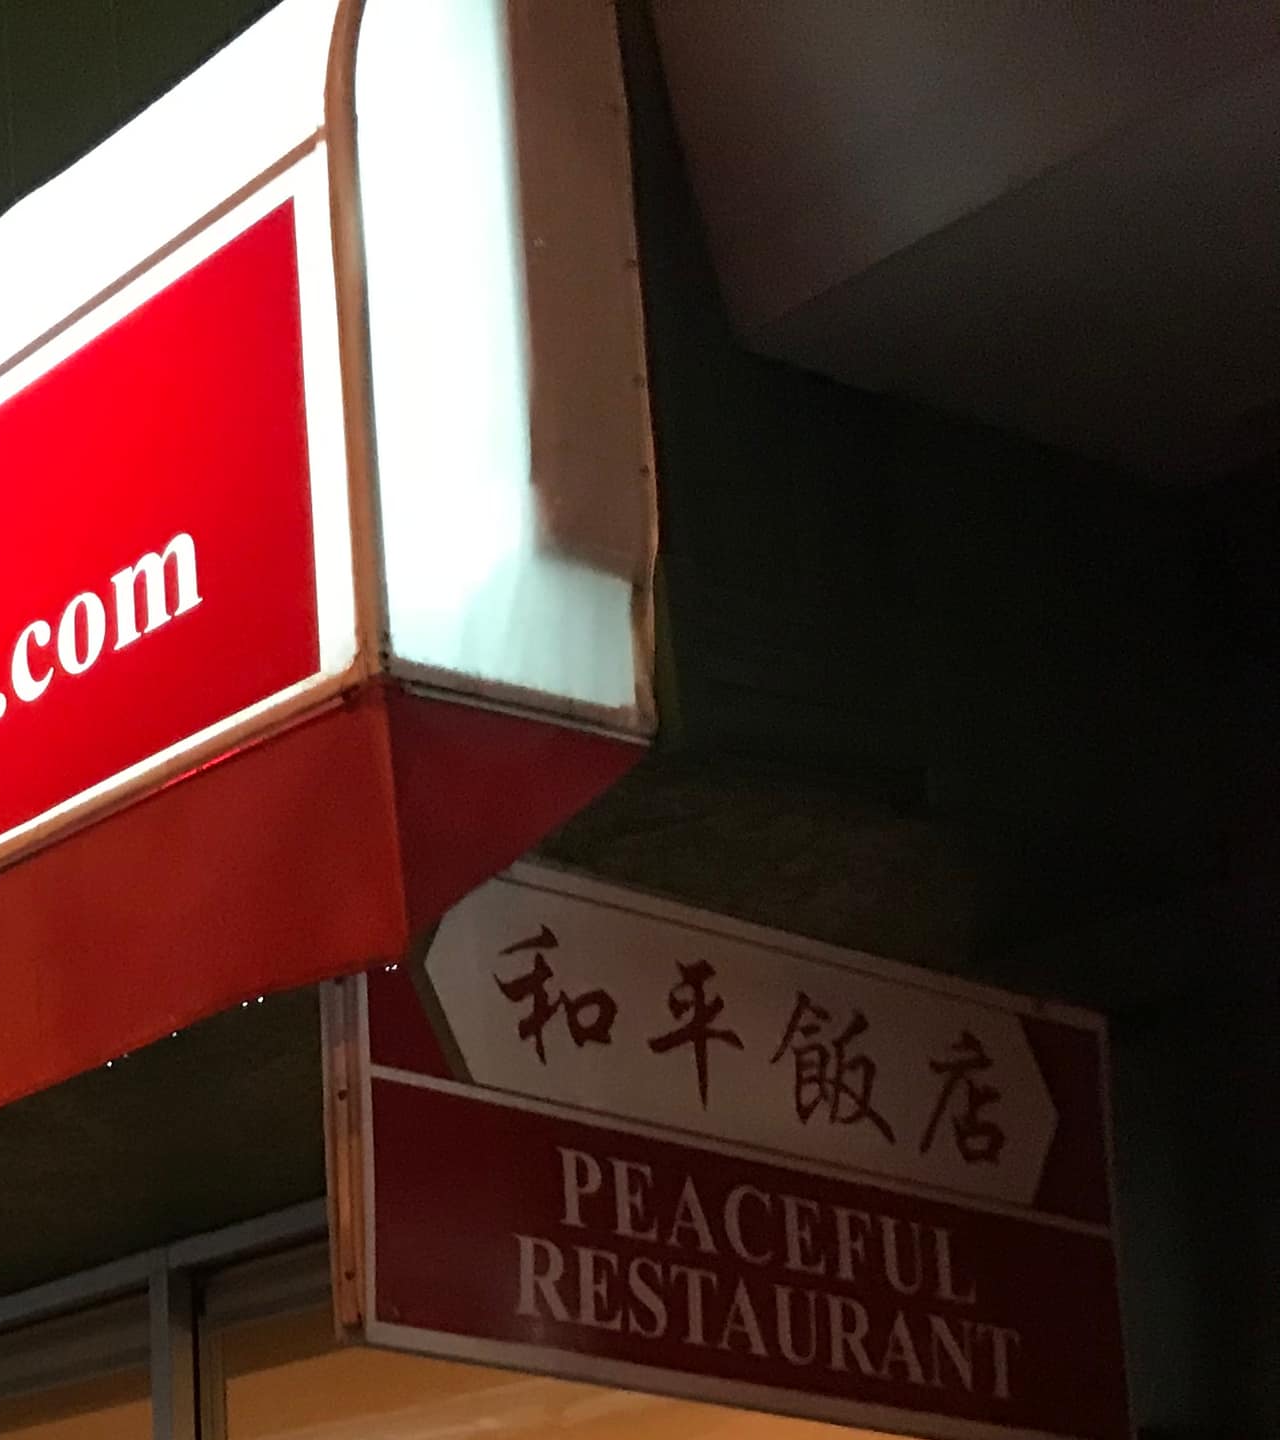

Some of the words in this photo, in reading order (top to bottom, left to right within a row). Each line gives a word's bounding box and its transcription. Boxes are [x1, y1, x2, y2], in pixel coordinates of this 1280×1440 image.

[492, 924, 1007, 1165] 和平飯店
[557, 1145, 978, 1306] PEACEFUL
[513, 1233, 1024, 1399] RESTAURANT
